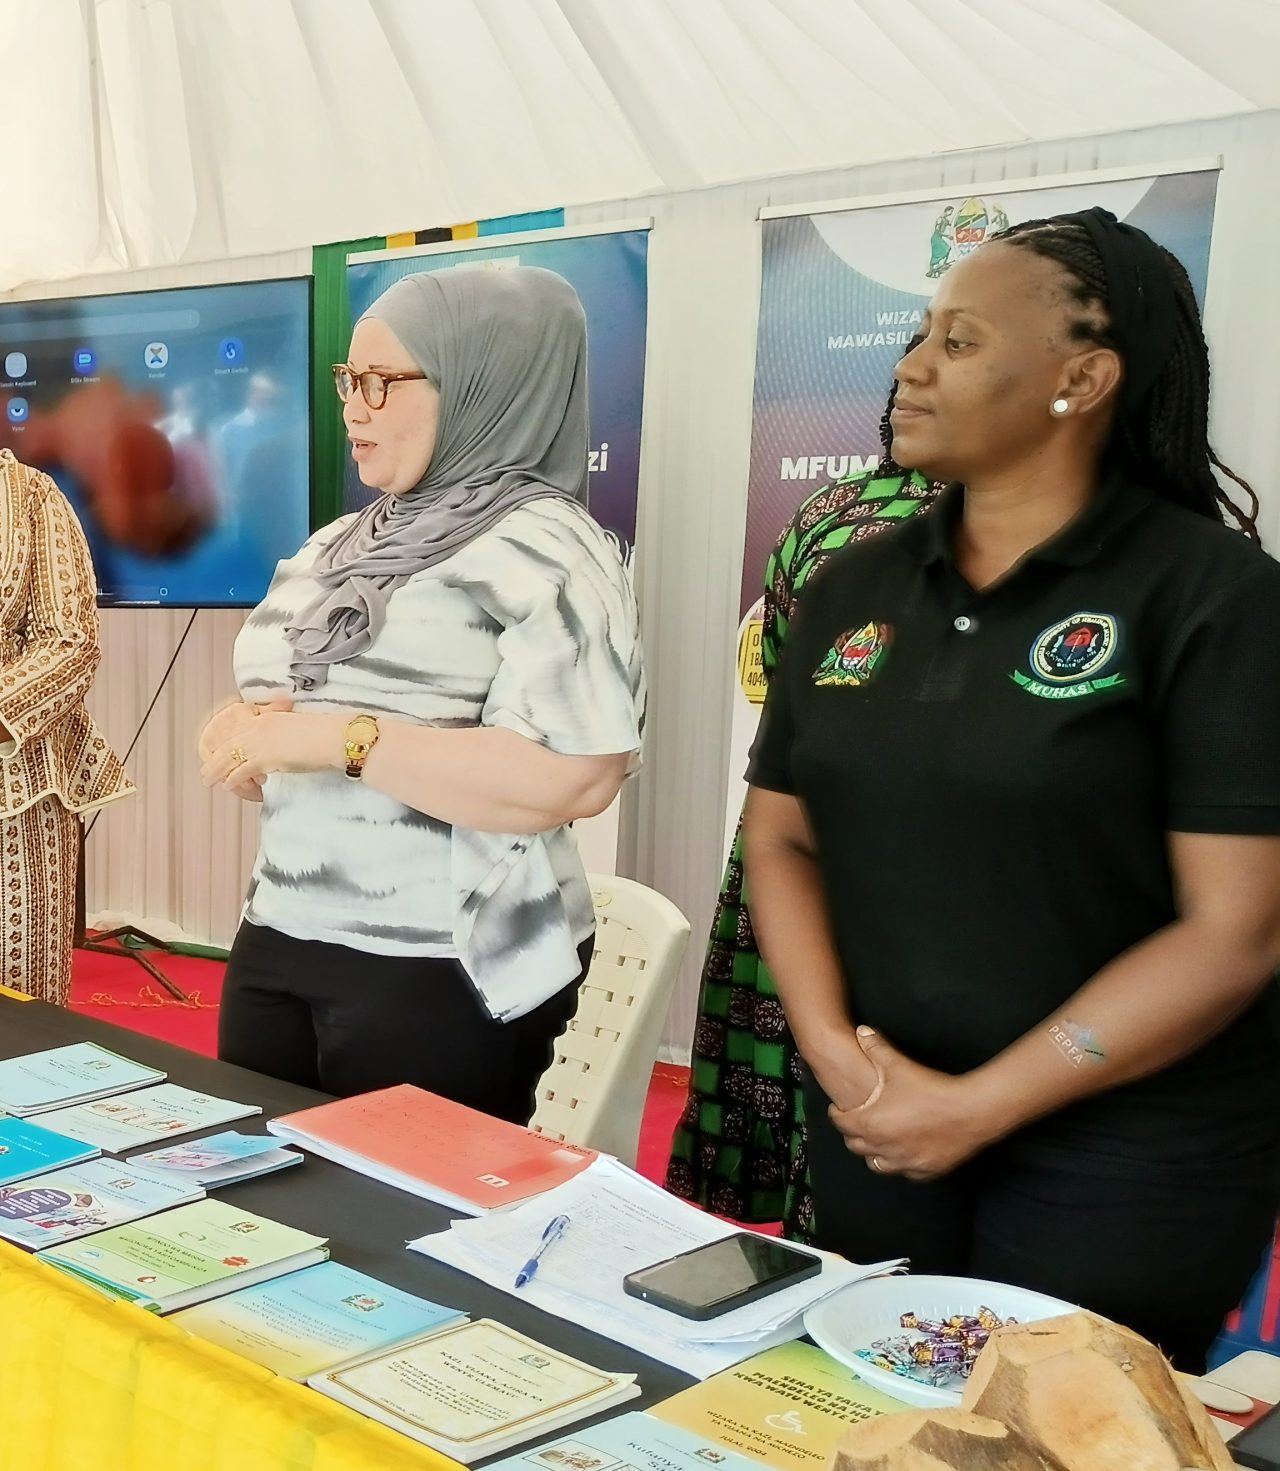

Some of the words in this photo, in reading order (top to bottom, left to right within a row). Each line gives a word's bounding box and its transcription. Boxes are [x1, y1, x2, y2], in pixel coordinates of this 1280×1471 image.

[876, 310, 921, 326] WIZA
[588, 442, 608, 472] zi
[780, 454, 883, 481] MFUM
[1027, 682, 1088, 699] MUHAS
[753, 1372, 825, 1402] MAENDELEO
[829, 1402, 848, 1411] NA
[764, 1385, 801, 1400] WATU
[802, 1400, 848, 1419] WENYE
[782, 1375, 815, 1389] SERA
[816, 1388, 834, 1396] YA
[835, 1396, 871, 1411] TAIFA
[707, 1410, 737, 1425] WIZARA
[775, 1439, 825, 1460] MAENDELEO
[627, 1442, 683, 1471] Kufanya
[747, 1446, 766, 1455] 2004
[768, 1442, 805, 1459] MICHEZO
